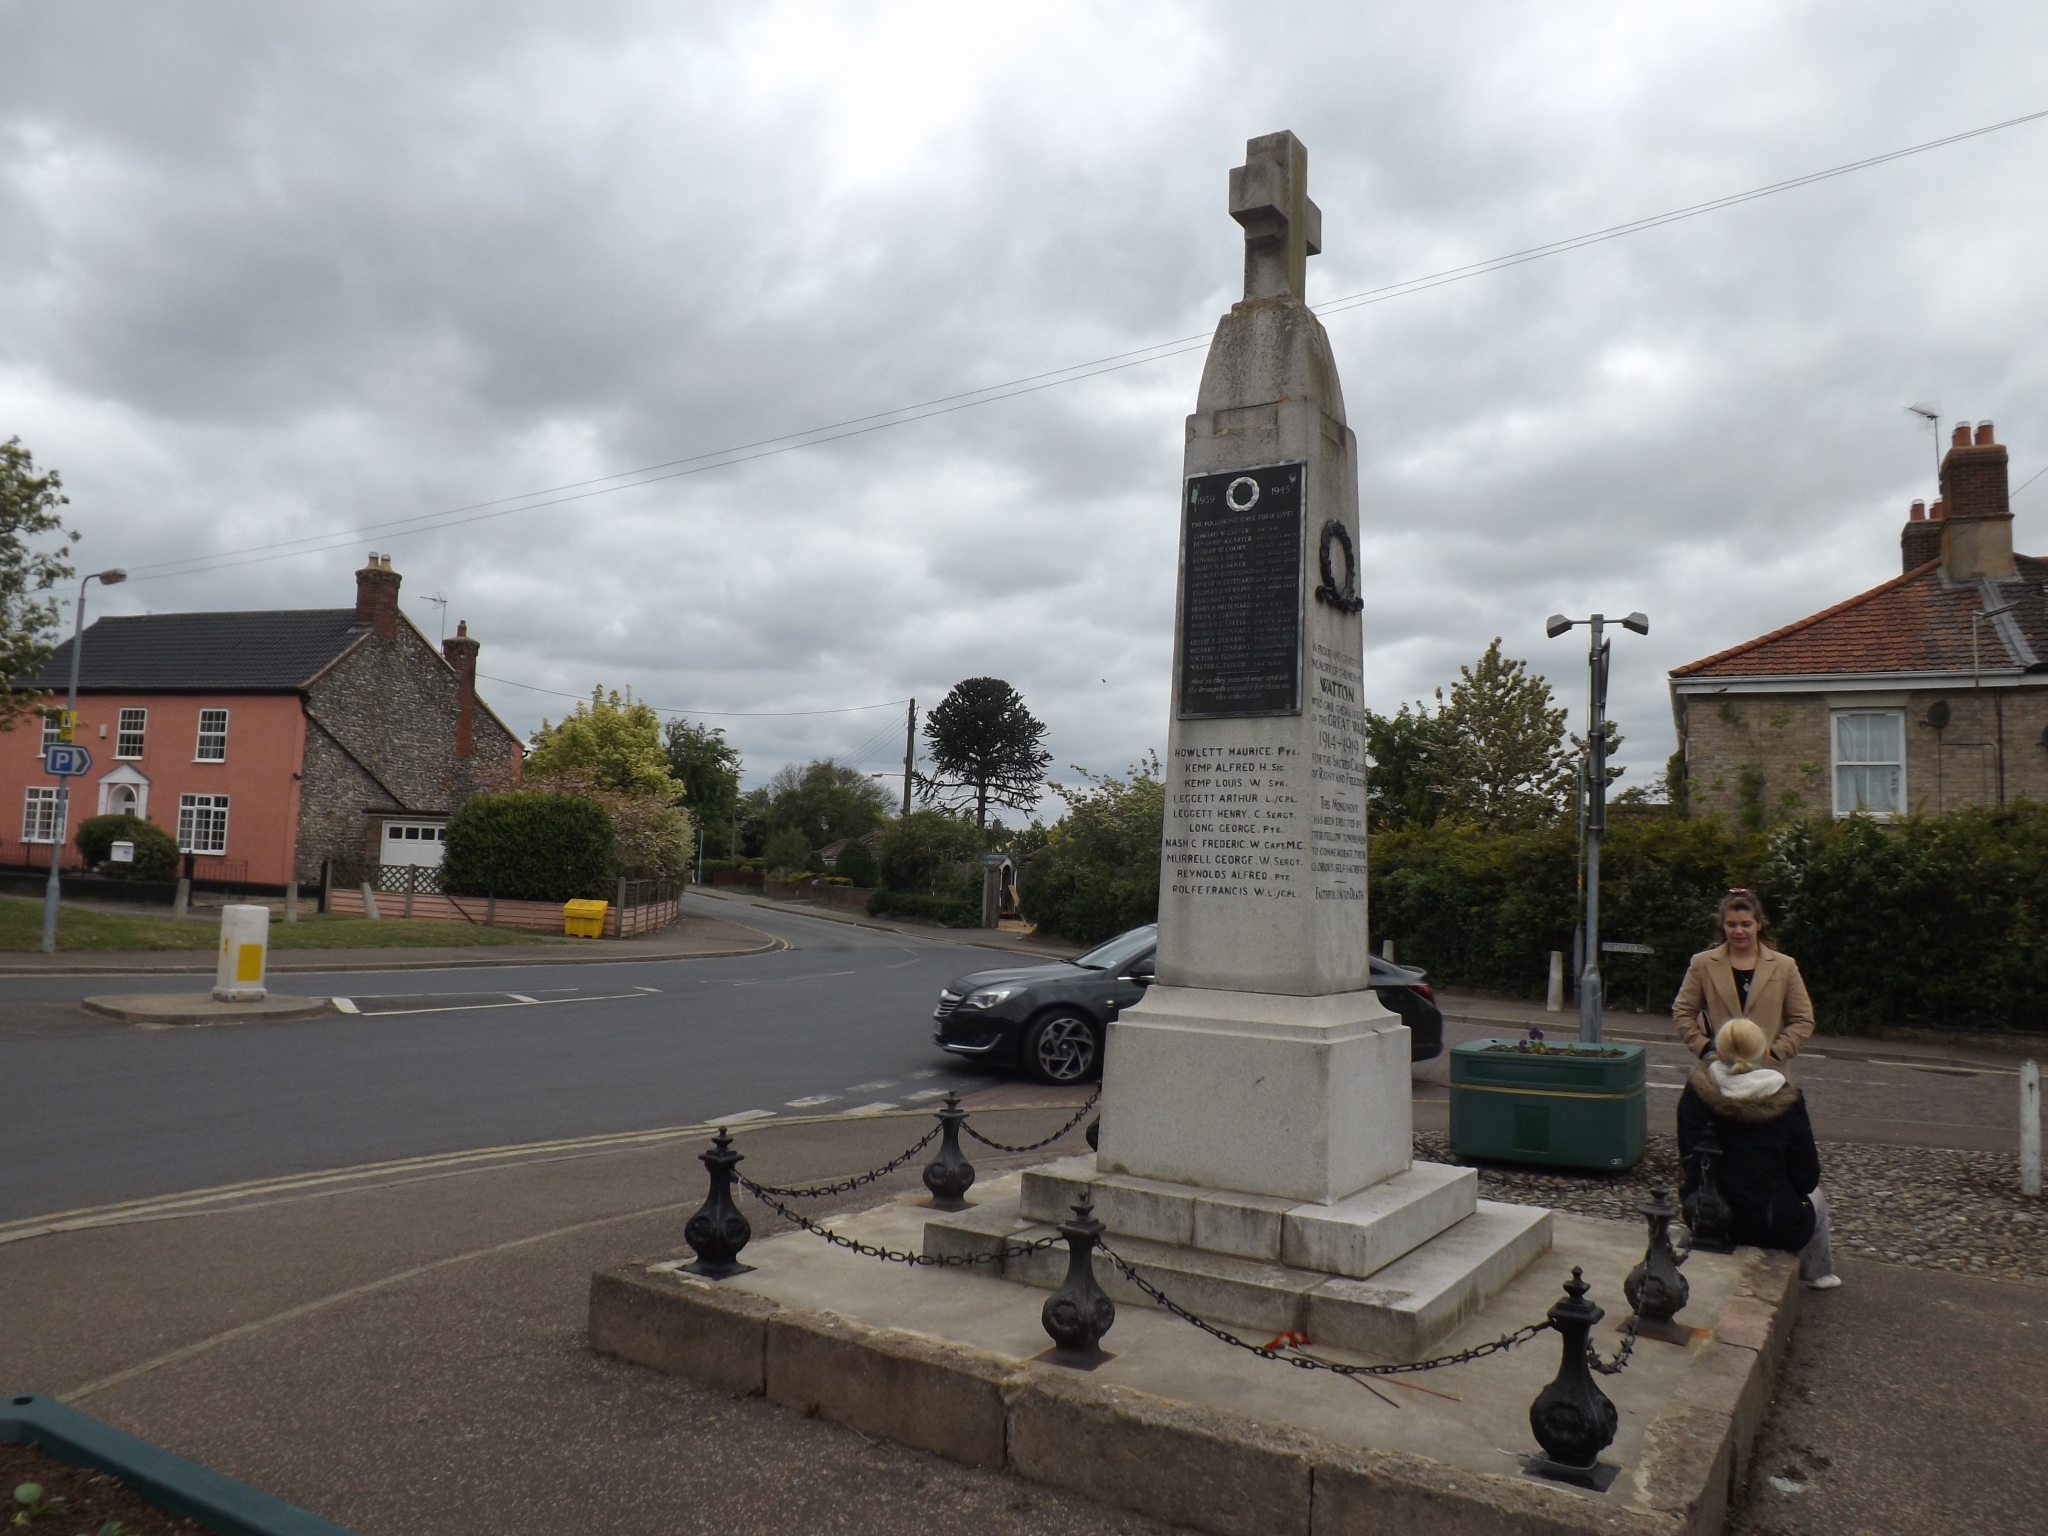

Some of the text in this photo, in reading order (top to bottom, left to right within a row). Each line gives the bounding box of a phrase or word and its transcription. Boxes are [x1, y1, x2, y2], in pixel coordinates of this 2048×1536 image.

[1271, 485, 1291, 496] 1945
[1320, 677, 1354, 703] WATTON
[1328, 713, 1350, 732] GREAT
[1175, 748, 1223, 757] HOWLETT
[56, 752, 69, 769] P
[1186, 764, 1212, 772] KEMP
[1185, 779, 1211, 787] KEMP
[1174, 795, 1215, 803] LEGGETT
[1174, 810, 1212, 818] LEGGETT
[1190, 824, 1213, 832] LONG
[1167, 855, 1211, 864] MURRELL
[1177, 870, 1226, 879] REYNOLDS
[1173, 885, 1202, 894] ROLFE
